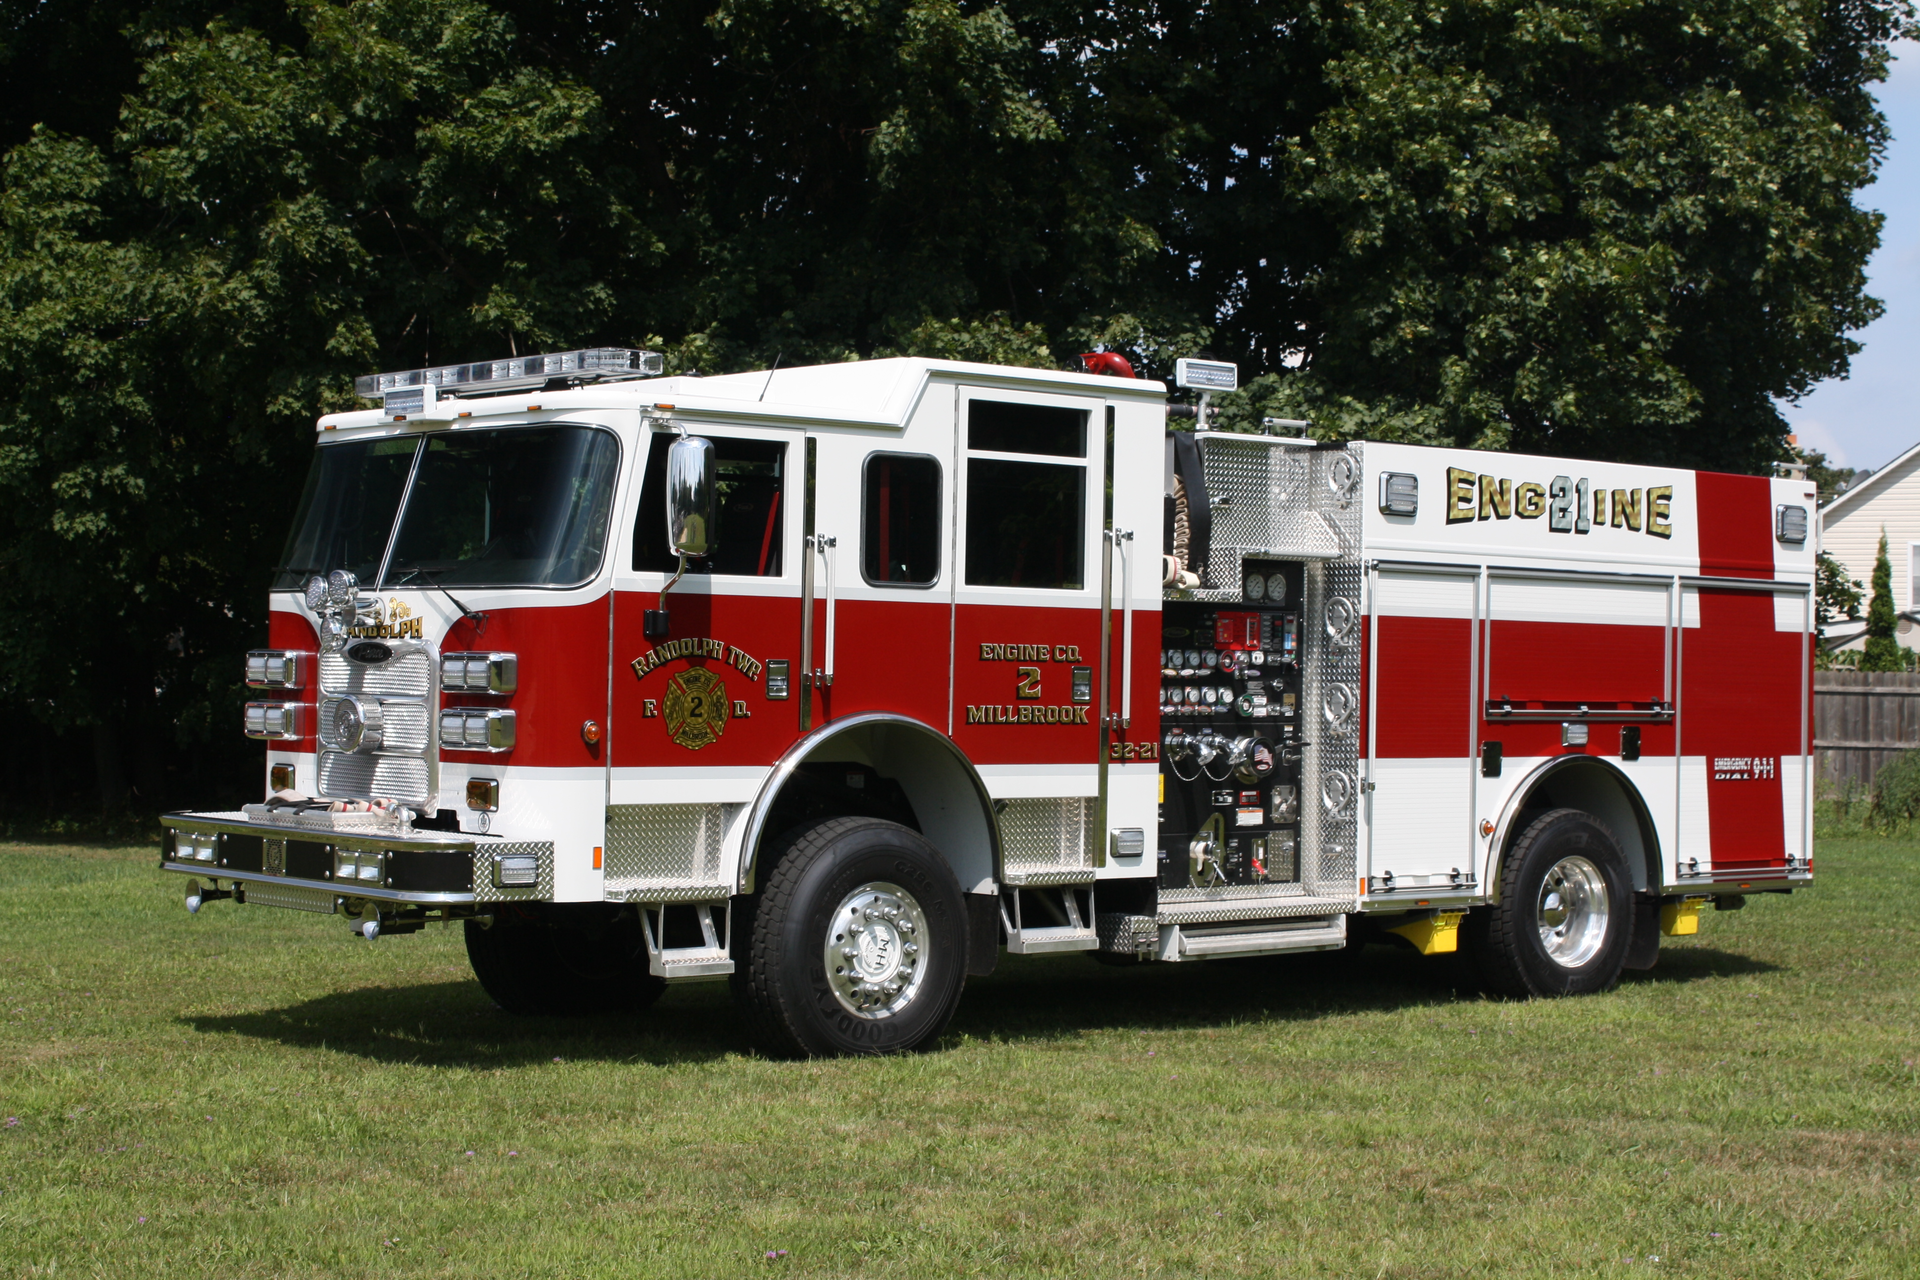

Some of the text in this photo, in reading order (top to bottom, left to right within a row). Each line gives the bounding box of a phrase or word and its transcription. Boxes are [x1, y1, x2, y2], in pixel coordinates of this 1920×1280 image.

[346, 616, 424, 639] ANDOLPH
[631, 638, 762, 681] RANDOLPH TWP.
[980, 643, 1082, 662] ENGINE CO.
[1017, 667, 1041, 700] 2
[689, 696, 703, 718] 2
[965, 705, 1090, 725] MILLBROOK
[1110, 742, 1158, 760] 32-21
[1714, 772, 1751, 781] DIAL
